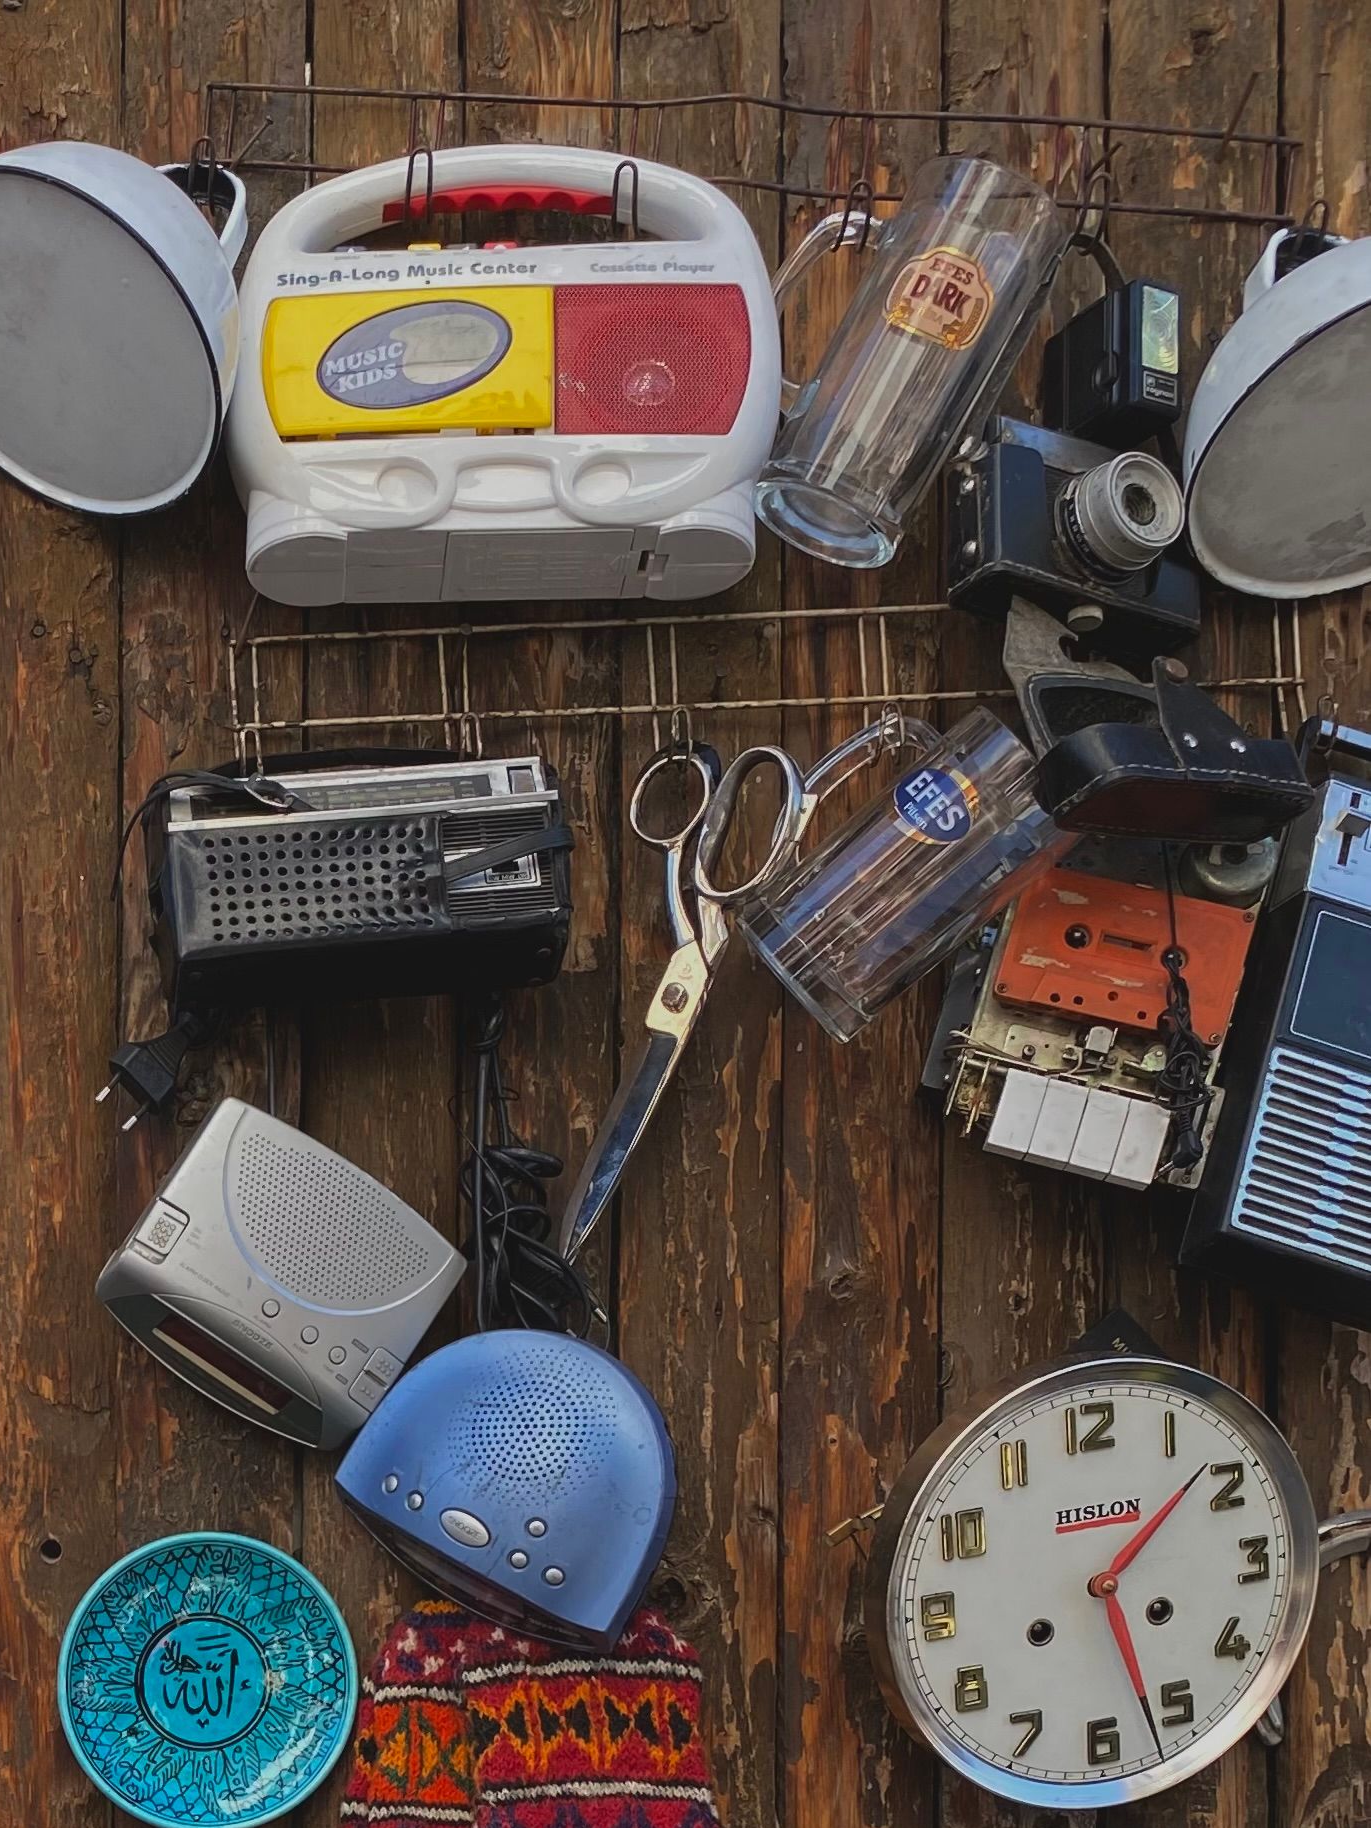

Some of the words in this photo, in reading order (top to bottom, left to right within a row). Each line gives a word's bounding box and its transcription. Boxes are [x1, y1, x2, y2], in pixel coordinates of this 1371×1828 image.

[277, 267, 400, 288] Sing-A-Long
[407, 262, 464, 278] Music
[470, 260, 538, 277] Center
[590, 262, 658, 274] Cassette
[662, 261, 715, 275] Player
[324, 341, 404, 377] MUSIC
[337, 363, 398, 393] KIDS
[903, 801, 929, 830] Pilsen
[905, 770, 966, 831] EFES
[1065, 1400, 1116, 1455] 12
[1164, 1410, 1176, 1457] 1
[1000, 1439, 1028, 1490] 11
[1210, 1460, 1245, 1511] 2
[941, 1507, 987, 1561] 10
[1057, 1498, 1141, 1525] HISLON
[1237, 1535, 1270, 1584] 3
[921, 1590, 956, 1641] 9
[1214, 1616, 1251, 1660] 4
[955, 1664, 989, 1712] 8
[1161, 1679, 1194, 1727] 5
[1009, 1708, 1043, 1758] 7
[1087, 1716, 1120, 1765] 6
